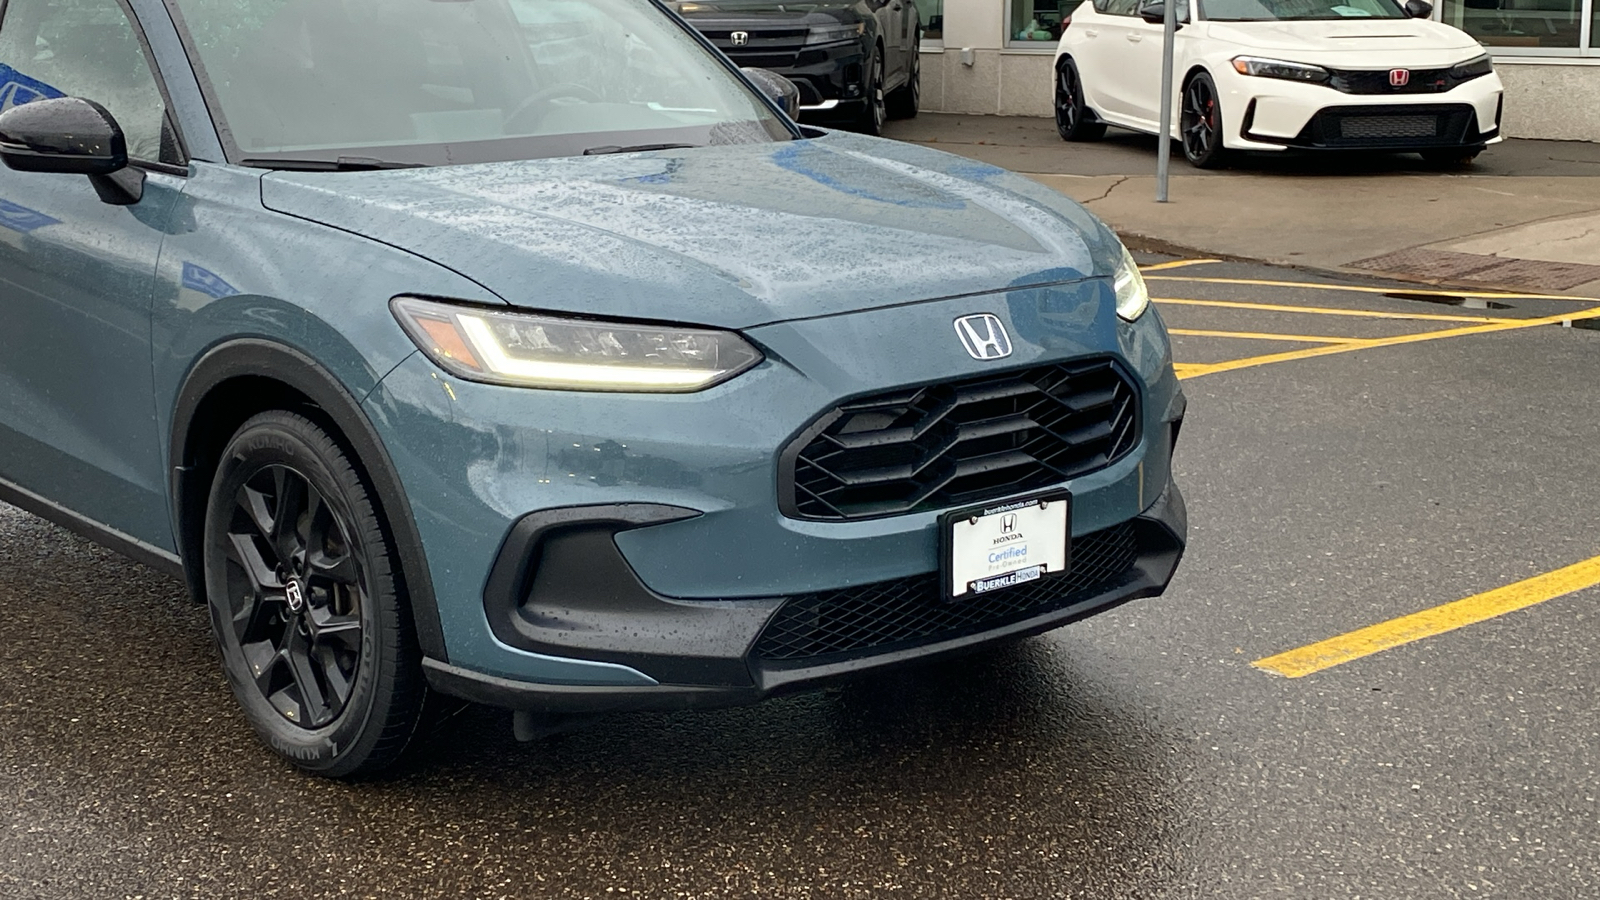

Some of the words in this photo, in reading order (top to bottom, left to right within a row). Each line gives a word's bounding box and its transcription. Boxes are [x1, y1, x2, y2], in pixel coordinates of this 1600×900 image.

[993, 533, 1023, 545] HONDA
[988, 545, 1027, 563] Certified
[988, 558, 1027, 572] Pre-Owned
[976, 575, 1016, 592] BUERKLE
[1017, 570, 1039, 582] HONDA
[271, 734, 320, 760] KUMHO
